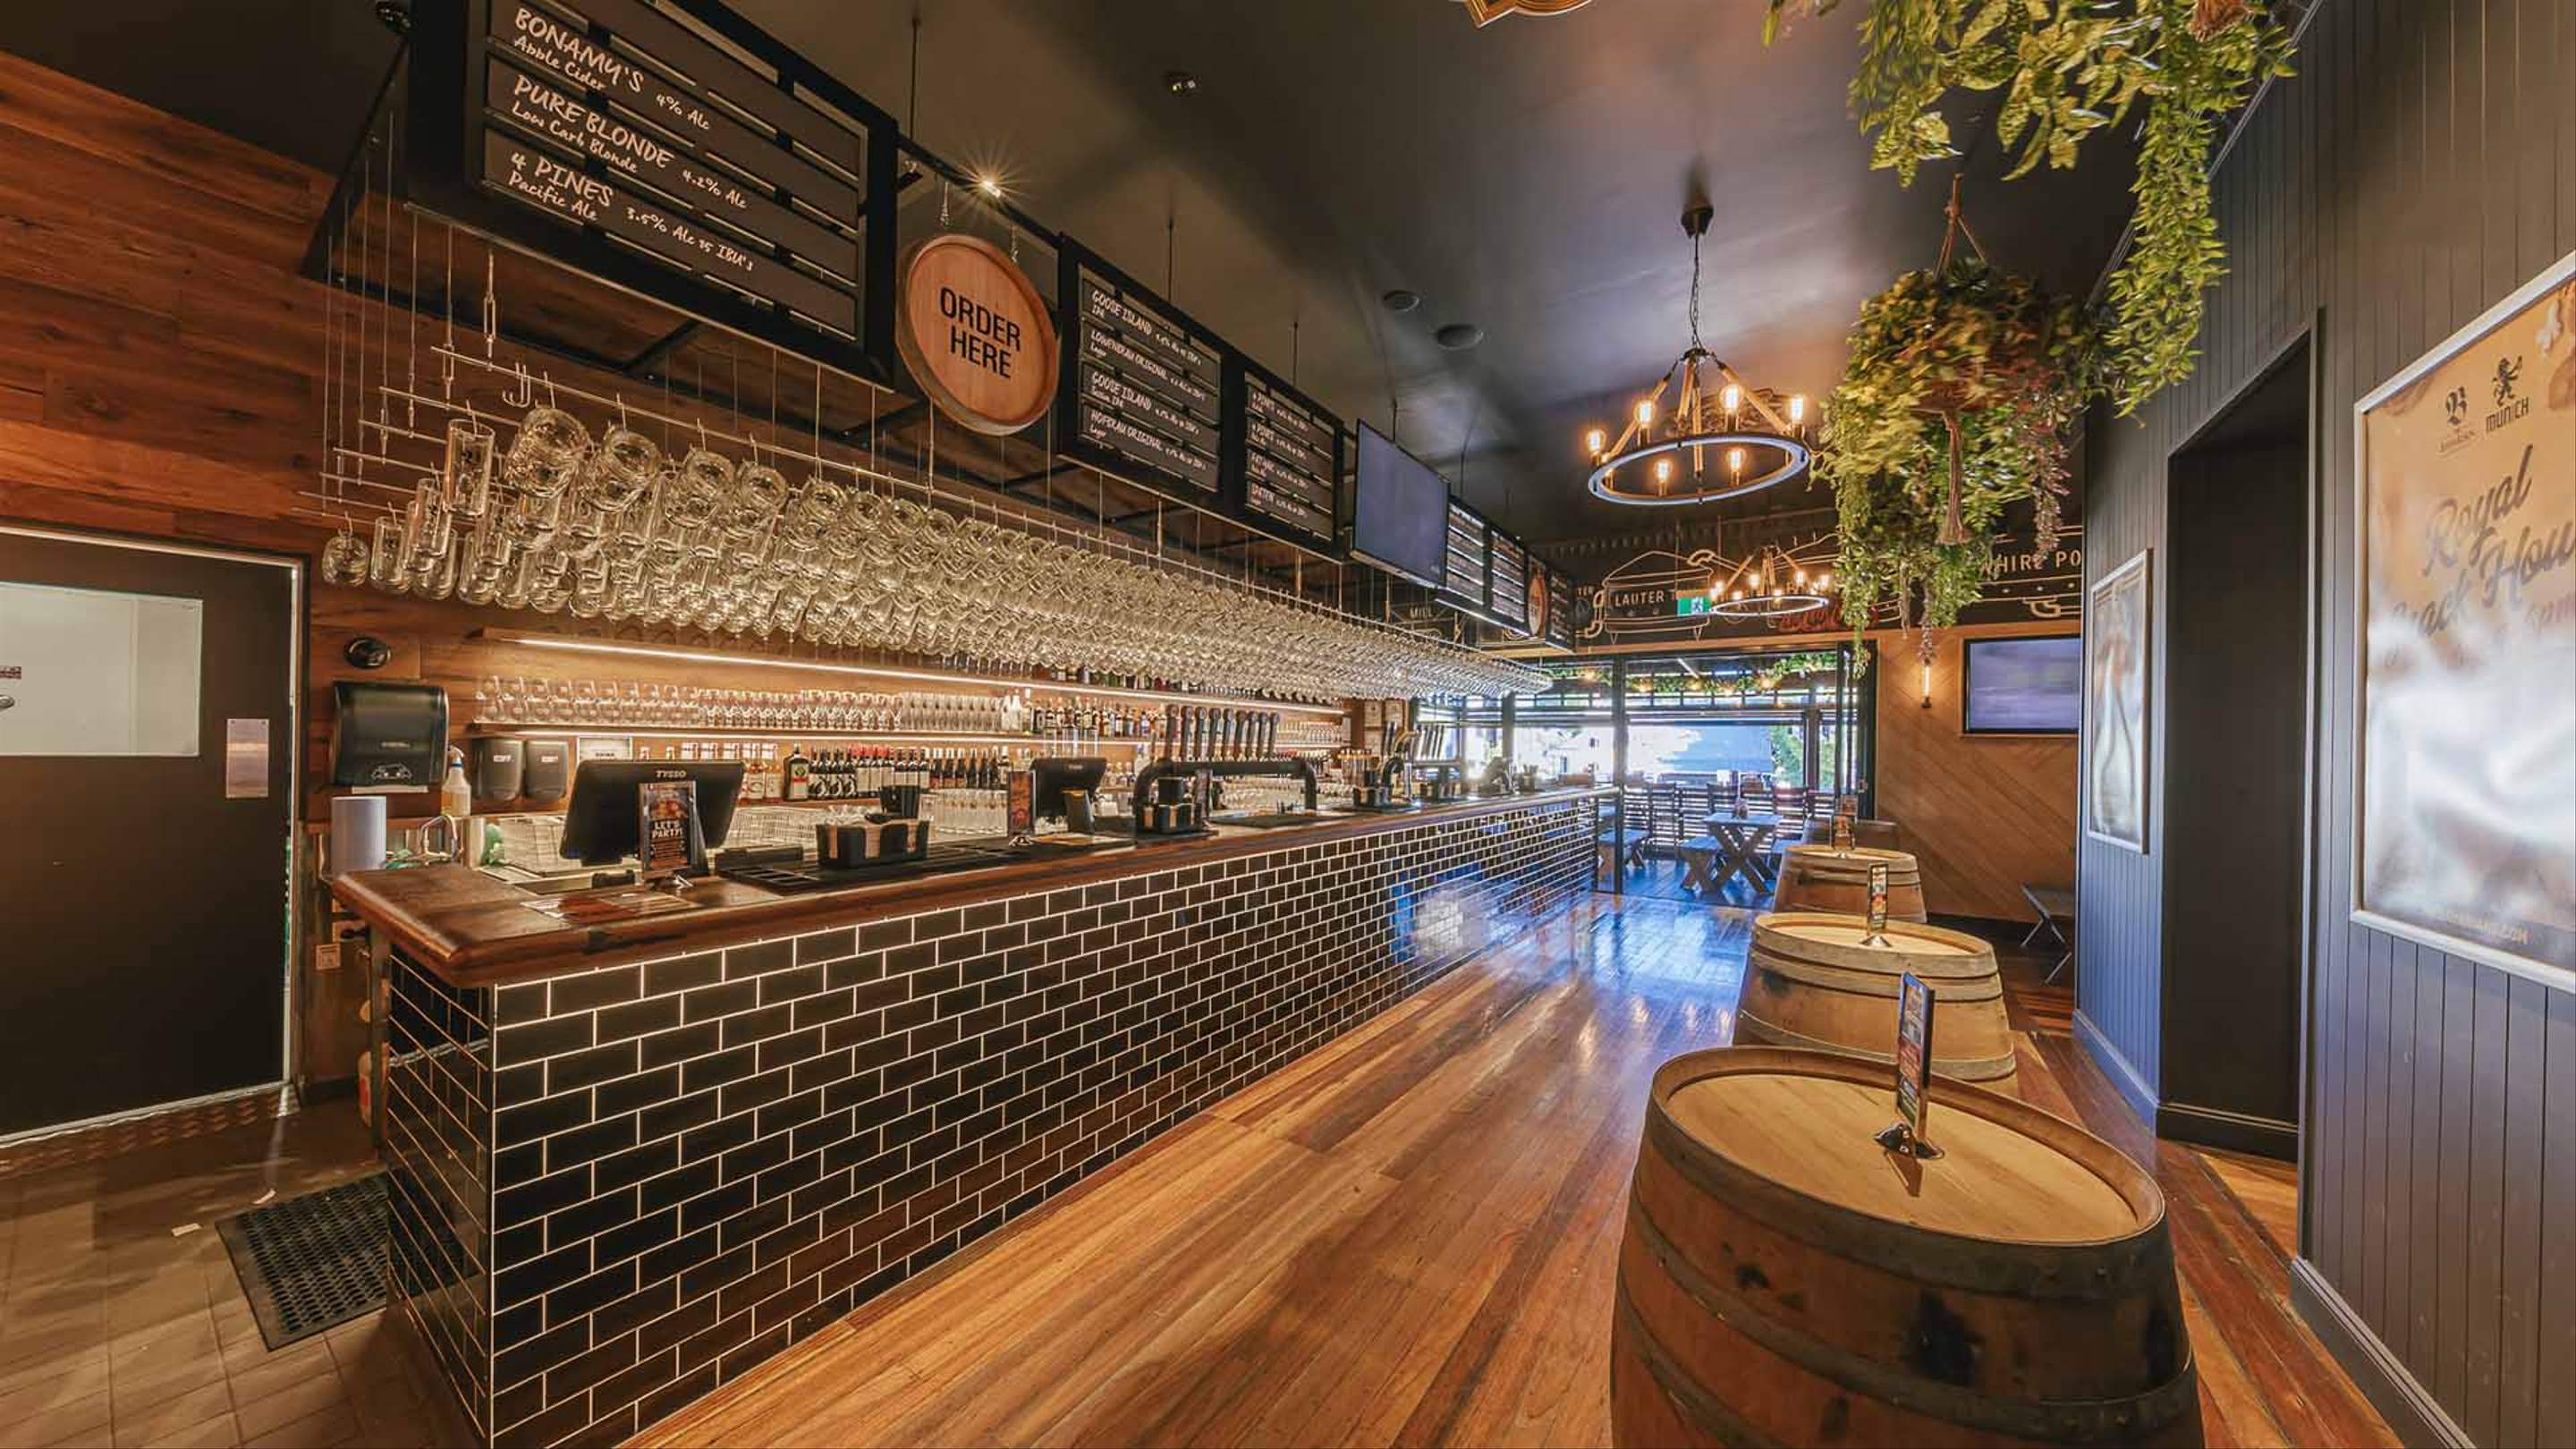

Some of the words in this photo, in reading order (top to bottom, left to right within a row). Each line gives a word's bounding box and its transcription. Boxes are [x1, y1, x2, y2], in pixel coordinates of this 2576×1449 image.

[514, 7, 645, 93] BONAMY'S
[564, 62, 607, 90] Cider
[514, 74, 587, 123] PURE
[586, 111, 675, 168] BLONDE
[656, 93, 682, 115] 4%
[512, 100, 545, 127] Low
[549, 120, 586, 148] Carb
[589, 138, 639, 174] Blonde
[508, 170, 566, 208] Pacific
[572, 199, 598, 221] Ale
[511, 152, 526, 171] 4
[534, 156, 614, 208] PINES
[940, 286, 1021, 352] ORDER
[1092, 290, 1123, 318] GOOSE
[951, 325, 1012, 379] HERE
[1092, 371, 1122, 395] GOOSE
[1121, 386, 1152, 411] ISLAND
[2421, 444, 2534, 578] Royal
[1614, 589, 1665, 607] LAUTER
[654, 820, 681, 830] LET'S
